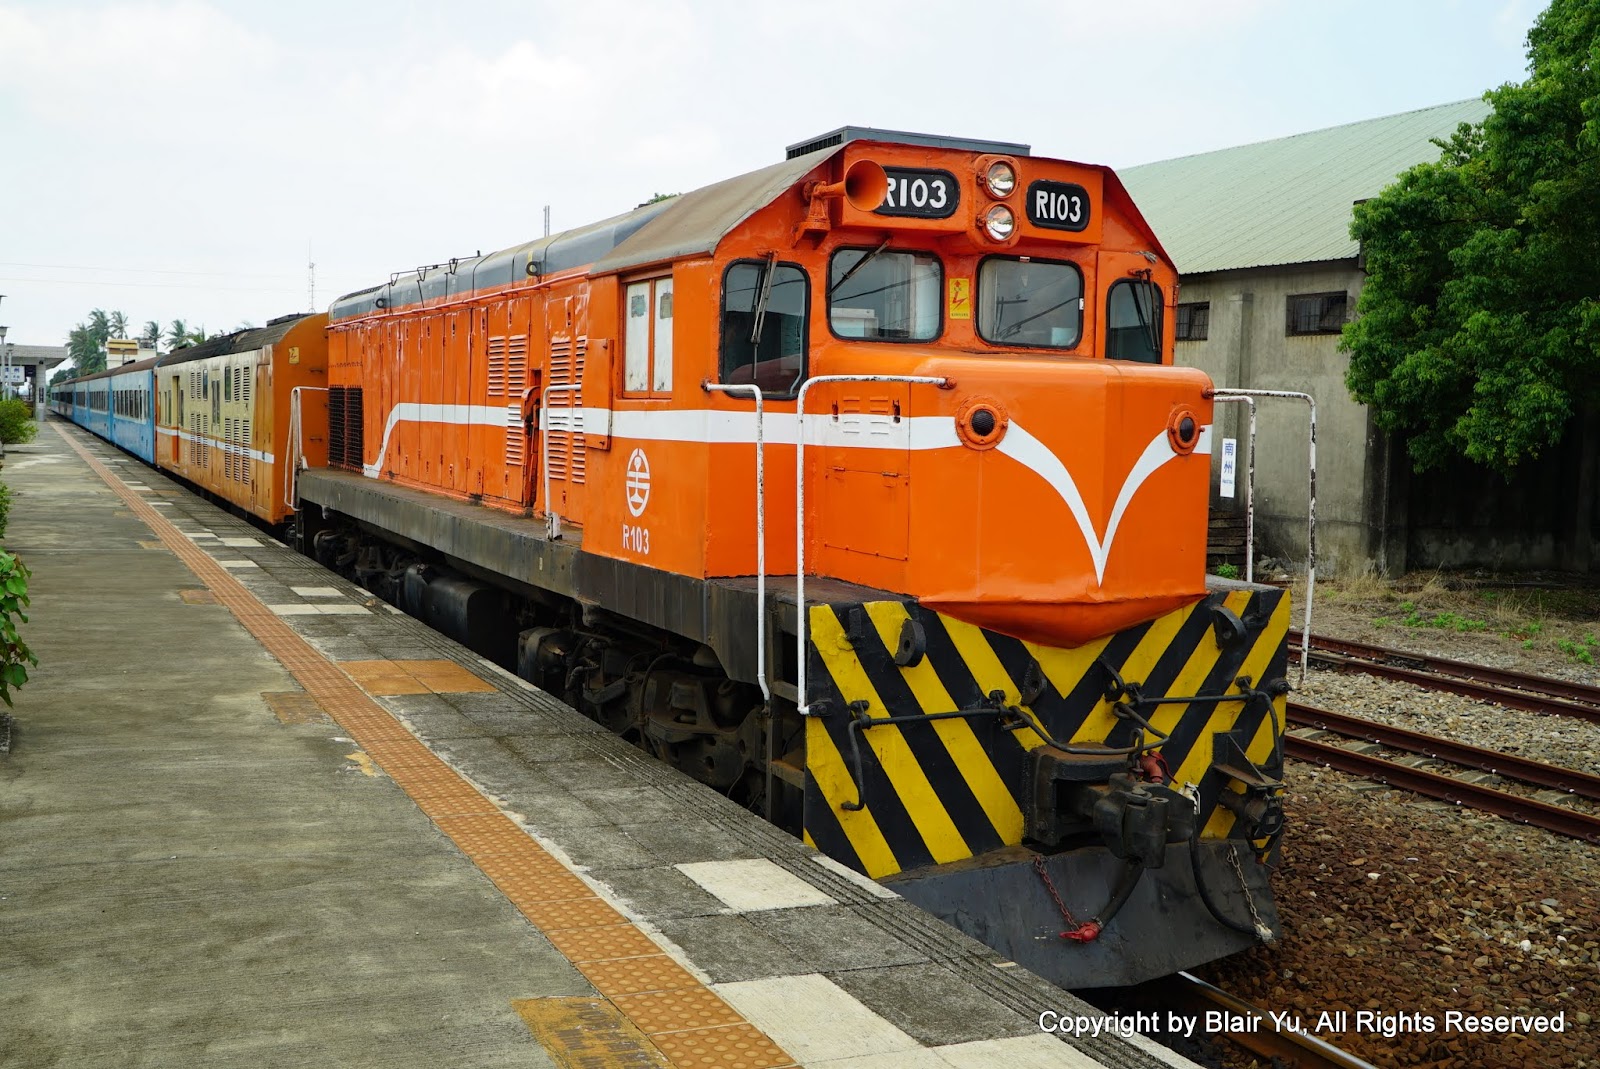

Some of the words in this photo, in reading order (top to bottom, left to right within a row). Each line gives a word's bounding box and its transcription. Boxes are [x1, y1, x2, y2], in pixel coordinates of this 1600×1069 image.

[1035, 190, 1082, 223] R103
[1223, 442, 1235, 475] 南州
[622, 523, 650, 555] R103
